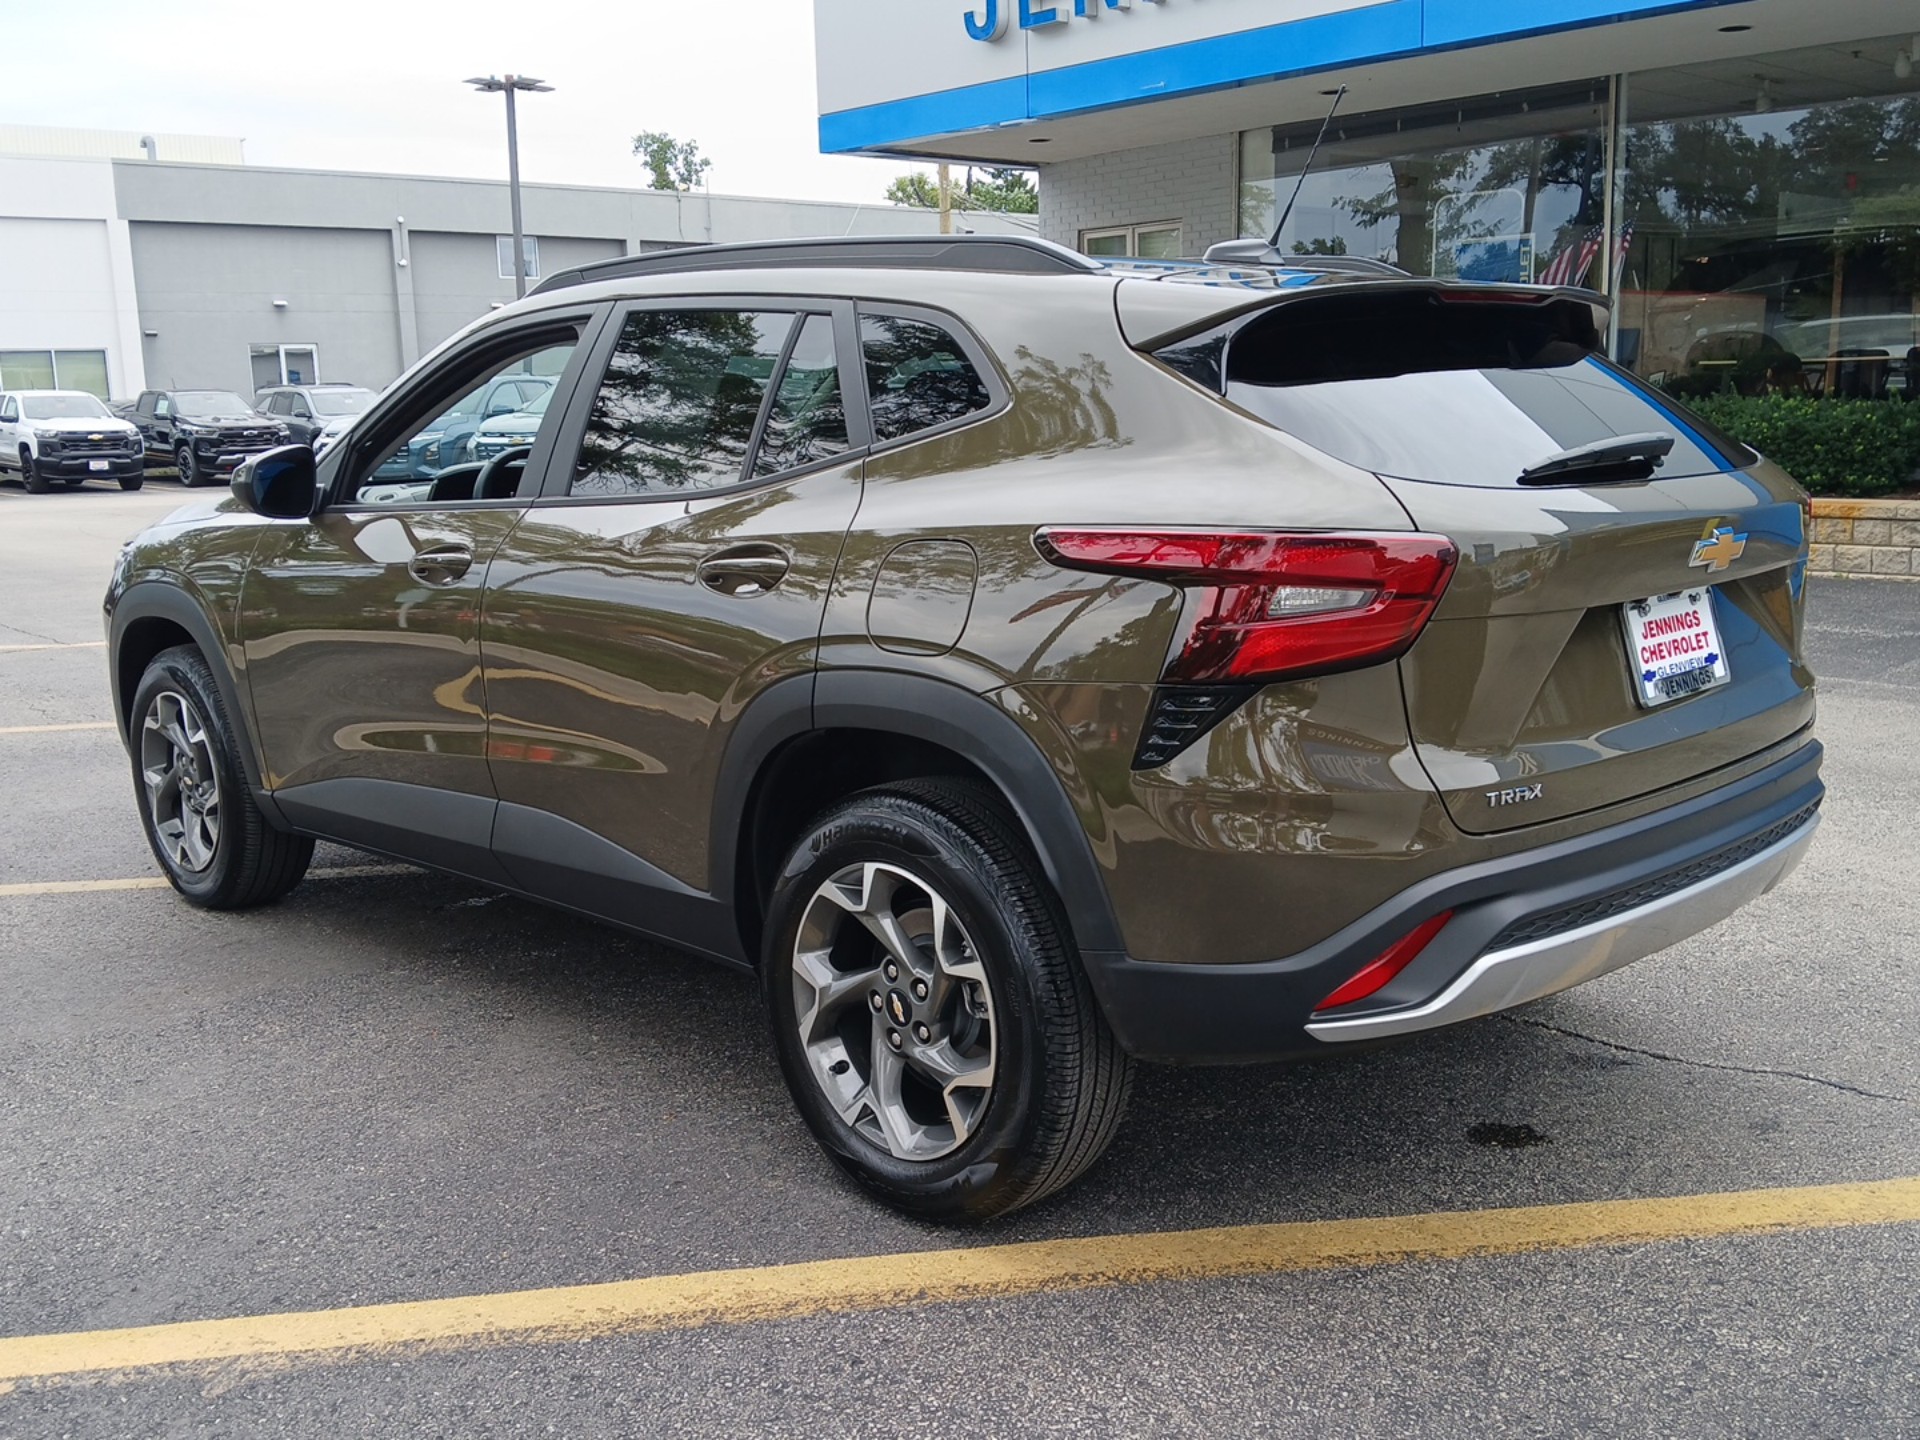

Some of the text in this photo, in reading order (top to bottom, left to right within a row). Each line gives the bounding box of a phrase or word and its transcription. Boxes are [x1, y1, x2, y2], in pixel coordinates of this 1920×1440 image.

[1642, 610, 1701, 640] JENNINGS
[1641, 631, 1709, 664] CHEVROLET
[1656, 656, 1705, 678] GLENVIEW
[1664, 670, 1713, 698] JENNINGS
[1485, 783, 1543, 807] TRAX
